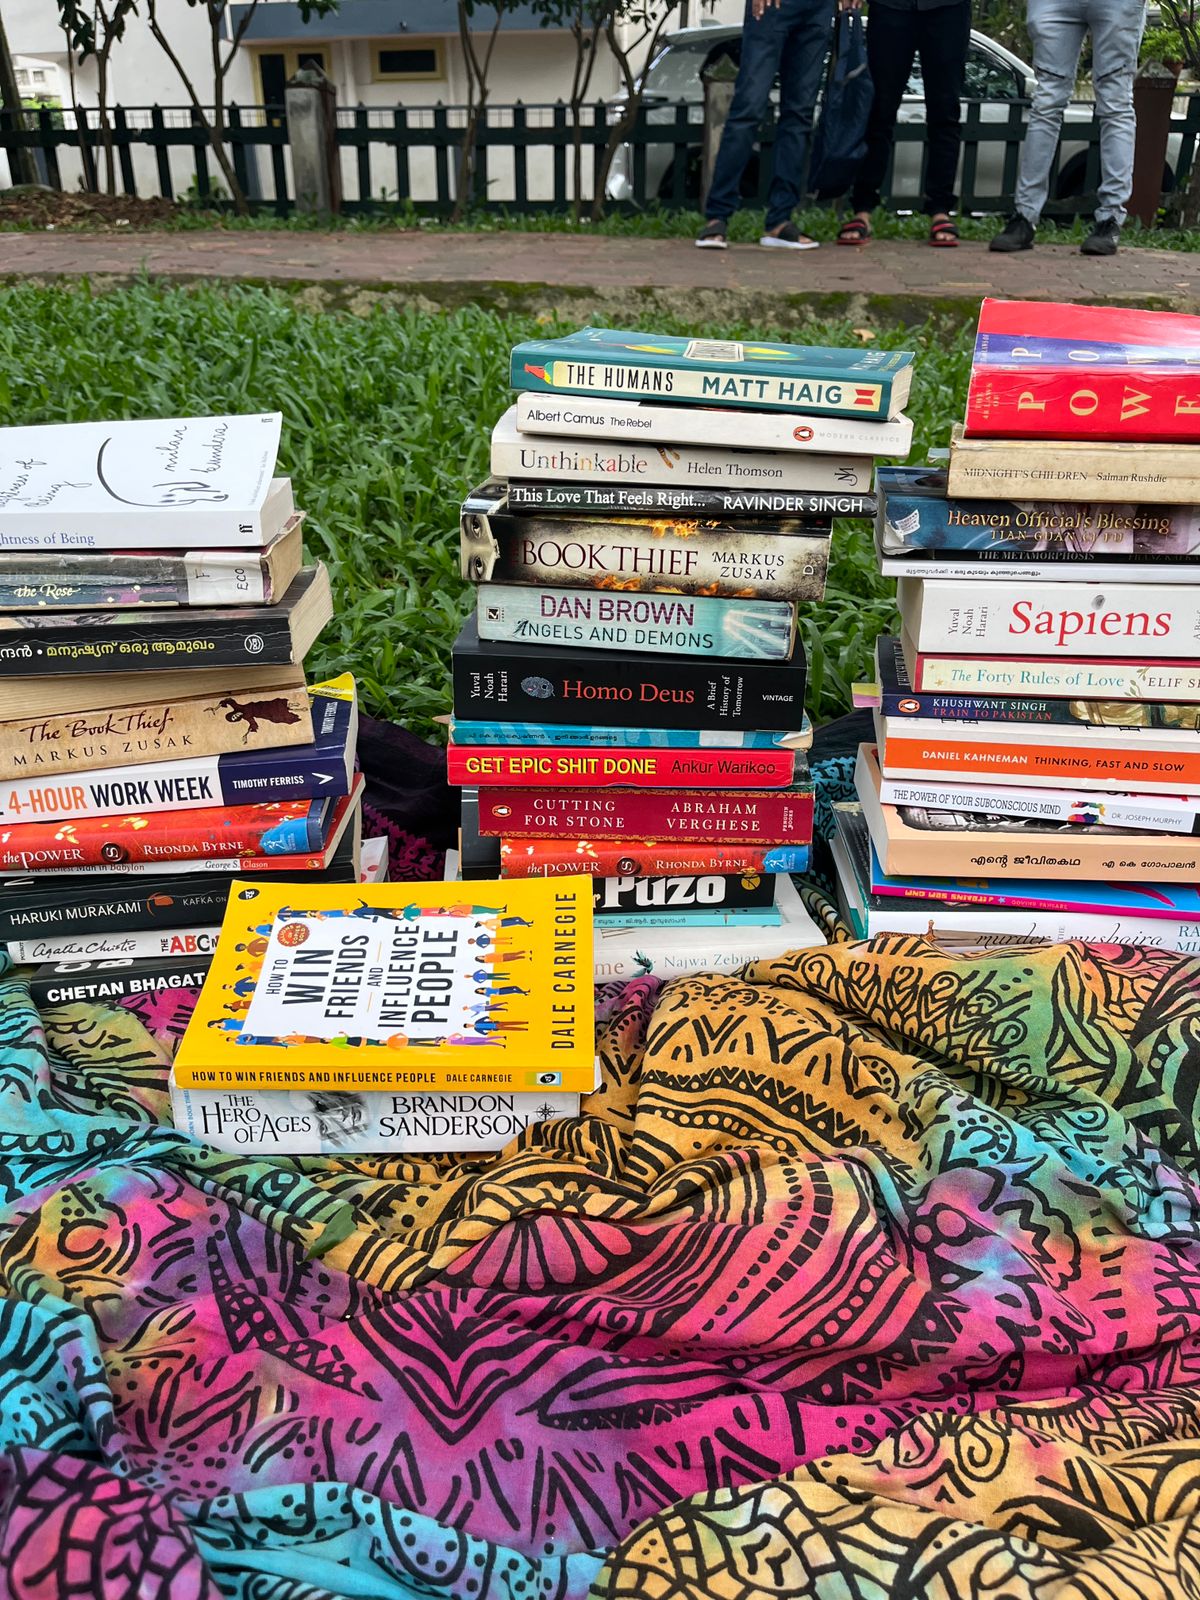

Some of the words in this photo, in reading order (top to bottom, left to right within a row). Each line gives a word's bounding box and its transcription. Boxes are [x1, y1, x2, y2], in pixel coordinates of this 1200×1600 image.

[567, 364, 596, 386] THE
[604, 367, 673, 392] HUMANS
[702, 376, 769, 399] MATT
[778, 382, 842, 404] HAIG
[527, 410, 560, 422] Albert
[564, 412, 605, 425] Camus
[627, 418, 652, 428] Rebel
[520, 449, 648, 473] Unthinkable
[688, 462, 722, 475] Helen
[726, 463, 783, 478] Thomson
[963, 468, 1029, 479] MIDNIGHT'S
[1031, 470, 1088, 481] CHILDREN
[1096, 472, 1129, 482] Salman
[1130, 473, 1167, 483] Rushdie
[513, 489, 542, 502] This
[547, 489, 580, 503] Love
[584, 490, 615, 504] That
[618, 491, 653, 505] Feels
[724, 496, 804, 511] RAVINDER
[809, 498, 863, 513] SINGH
[947, 510, 1010, 527] Heaven
[1015, 511, 1091, 529] Official's
[1096, 513, 1170, 535] Blessing
[44, 532, 56, 544] of
[60, 532, 96, 547] Being
[991, 530, 1027, 541] TIAN
[523, 540, 609, 571] BOOK
[612, 546, 698, 576] THIEF
[712, 551, 785, 566] MARKUS
[234, 568, 248, 591] ECO
[720, 566, 776, 581] ZUSAK
[14, 586, 37, 597] the
[40, 583, 81, 600] Rose
[541, 595, 591, 619] DAN
[599, 598, 694, 626] BROWN
[948, 608, 960, 635] Yuval
[962, 608, 974, 635] Noah
[976, 606, 988, 638] Harari
[513, 618, 583, 640] ANGELS
[589, 627, 627, 643] AND
[635, 630, 713, 649] DEMONS
[1008, 600, 1172, 646] Sapiens
[119, 641, 149, 655] ഒരു
[151, 639, 215, 655] ആമുഖം
[470, 672, 481, 698] Yuval
[484, 672, 494, 699] Noah
[498, 671, 508, 702] Harari
[951, 669, 971, 681] The
[977, 669, 1015, 685] Forty
[1020, 671, 1060, 685] Rules
[1066, 672, 1083, 685] of
[1087, 673, 1124, 686] Love
[1149, 677, 1182, 688] ELIF
[562, 680, 633, 700] Homo
[640, 683, 694, 703] Deus
[733, 677, 744, 717] Tomorrow
[762, 694, 794, 702] VINTAGE
[933, 699, 1007, 710] KHUSHWANT
[1010, 701, 1046, 711] SINGH
[933, 708, 969, 717] TRAIN
[993, 710, 1052, 721] PAKISTAN
[19, 719, 61, 743] The
[65, 713, 127, 738] Book
[118, 708, 173, 735] Thief
[13, 745, 108, 767] MARKUS
[123, 734, 192, 753] ZUSAK
[922, 751, 961, 762] DANIEL
[963, 752, 1029, 765] KAHNEMAN
[1035, 756, 1092, 769] THINKING,
[1096, 760, 1121, 769] FAST
[1124, 761, 1149, 770] AND
[1153, 762, 1185, 772] SLOW
[466, 757, 504, 774] GET
[509, 757, 552, 774] EPIC
[557, 758, 599, 775] SHIT
[603, 758, 657, 775] DONE
[671, 760, 713, 774] Ankur
[717, 760, 776, 775] Warikoo
[8, 785, 88, 815] 4-HOUR
[90, 780, 152, 808] WORK
[153, 776, 213, 802] WEEK
[232, 778, 268, 790] TIMOTHY
[270, 775, 305, 787] FERRISS
[533, 798, 615, 812] CUTTING
[671, 803, 757, 815] ABRAHAM
[893, 789, 908, 800] THE
[909, 790, 937, 803] POWER
[939, 793, 951, 804] OF
[952, 794, 973, 806] YOUR
[975, 797, 1038, 813] SUBCONSCIOUS
[1039, 804, 1061, 815] MIND
[1124, 813, 1151, 823] JOSEPH
[1152, 815, 1182, 825] MURPHY
[524, 815, 558, 826] FOR
[566, 815, 625, 828] STONE
[666, 818, 760, 832] VERGHESE
[3, 852, 20, 864] the
[143, 844, 198, 855] RHONDA
[202, 841, 244, 852] BYRNE
[205, 860, 229, 870] George
[242, 860, 268, 868] Clason
[527, 863, 541, 873] the
[656, 860, 705, 869] RHONDA
[710, 859, 749, 869] BYRNE
[1014, 855, 1081, 867] ജീവിതകഥ
[10, 911, 62, 925] HARUKI
[67, 902, 141, 920] MURAKAMI
[182, 896, 213, 906] KAFKA
[85, 938, 137, 953] Christie
[170, 934, 211, 953] ABC
[553, 893, 576, 993] CARNEGIE
[272, 959, 288, 971] TO
[664, 956, 707, 969] Najwa
[47, 982, 124, 1002] CHETAN
[130, 972, 206, 993] BHAGAT
[266, 973, 285, 994] HOW
[282, 950, 334, 1004] WIN
[324, 935, 369, 1018] FRIENDS
[367, 967, 384, 987] AND
[377, 925, 420, 1028] INFLUENCE
[411, 930, 459, 1023] PEOPLE
[551, 1005, 575, 1049] DALE
[192, 1071, 216, 1081] HOW
[219, 1071, 232, 1081] TO
[236, 1071, 256, 1082] WIN
[259, 1072, 305, 1082] FRIENDS
[309, 1072, 330, 1082] AND
[333, 1072, 393, 1083] INFLUENCE
[396, 1073, 436, 1083] PEOPLE
[446, 1074, 468, 1082] DALE
[470, 1074, 512, 1083] CARNEGIE
[224, 1094, 255, 1107] THE
[392, 1095, 514, 1116] BRANDON
[201, 1102, 261, 1134] HERO
[234, 1125, 261, 1143] OF
[260, 1114, 311, 1142] AGES
[379, 1115, 529, 1139] SANDERSON
